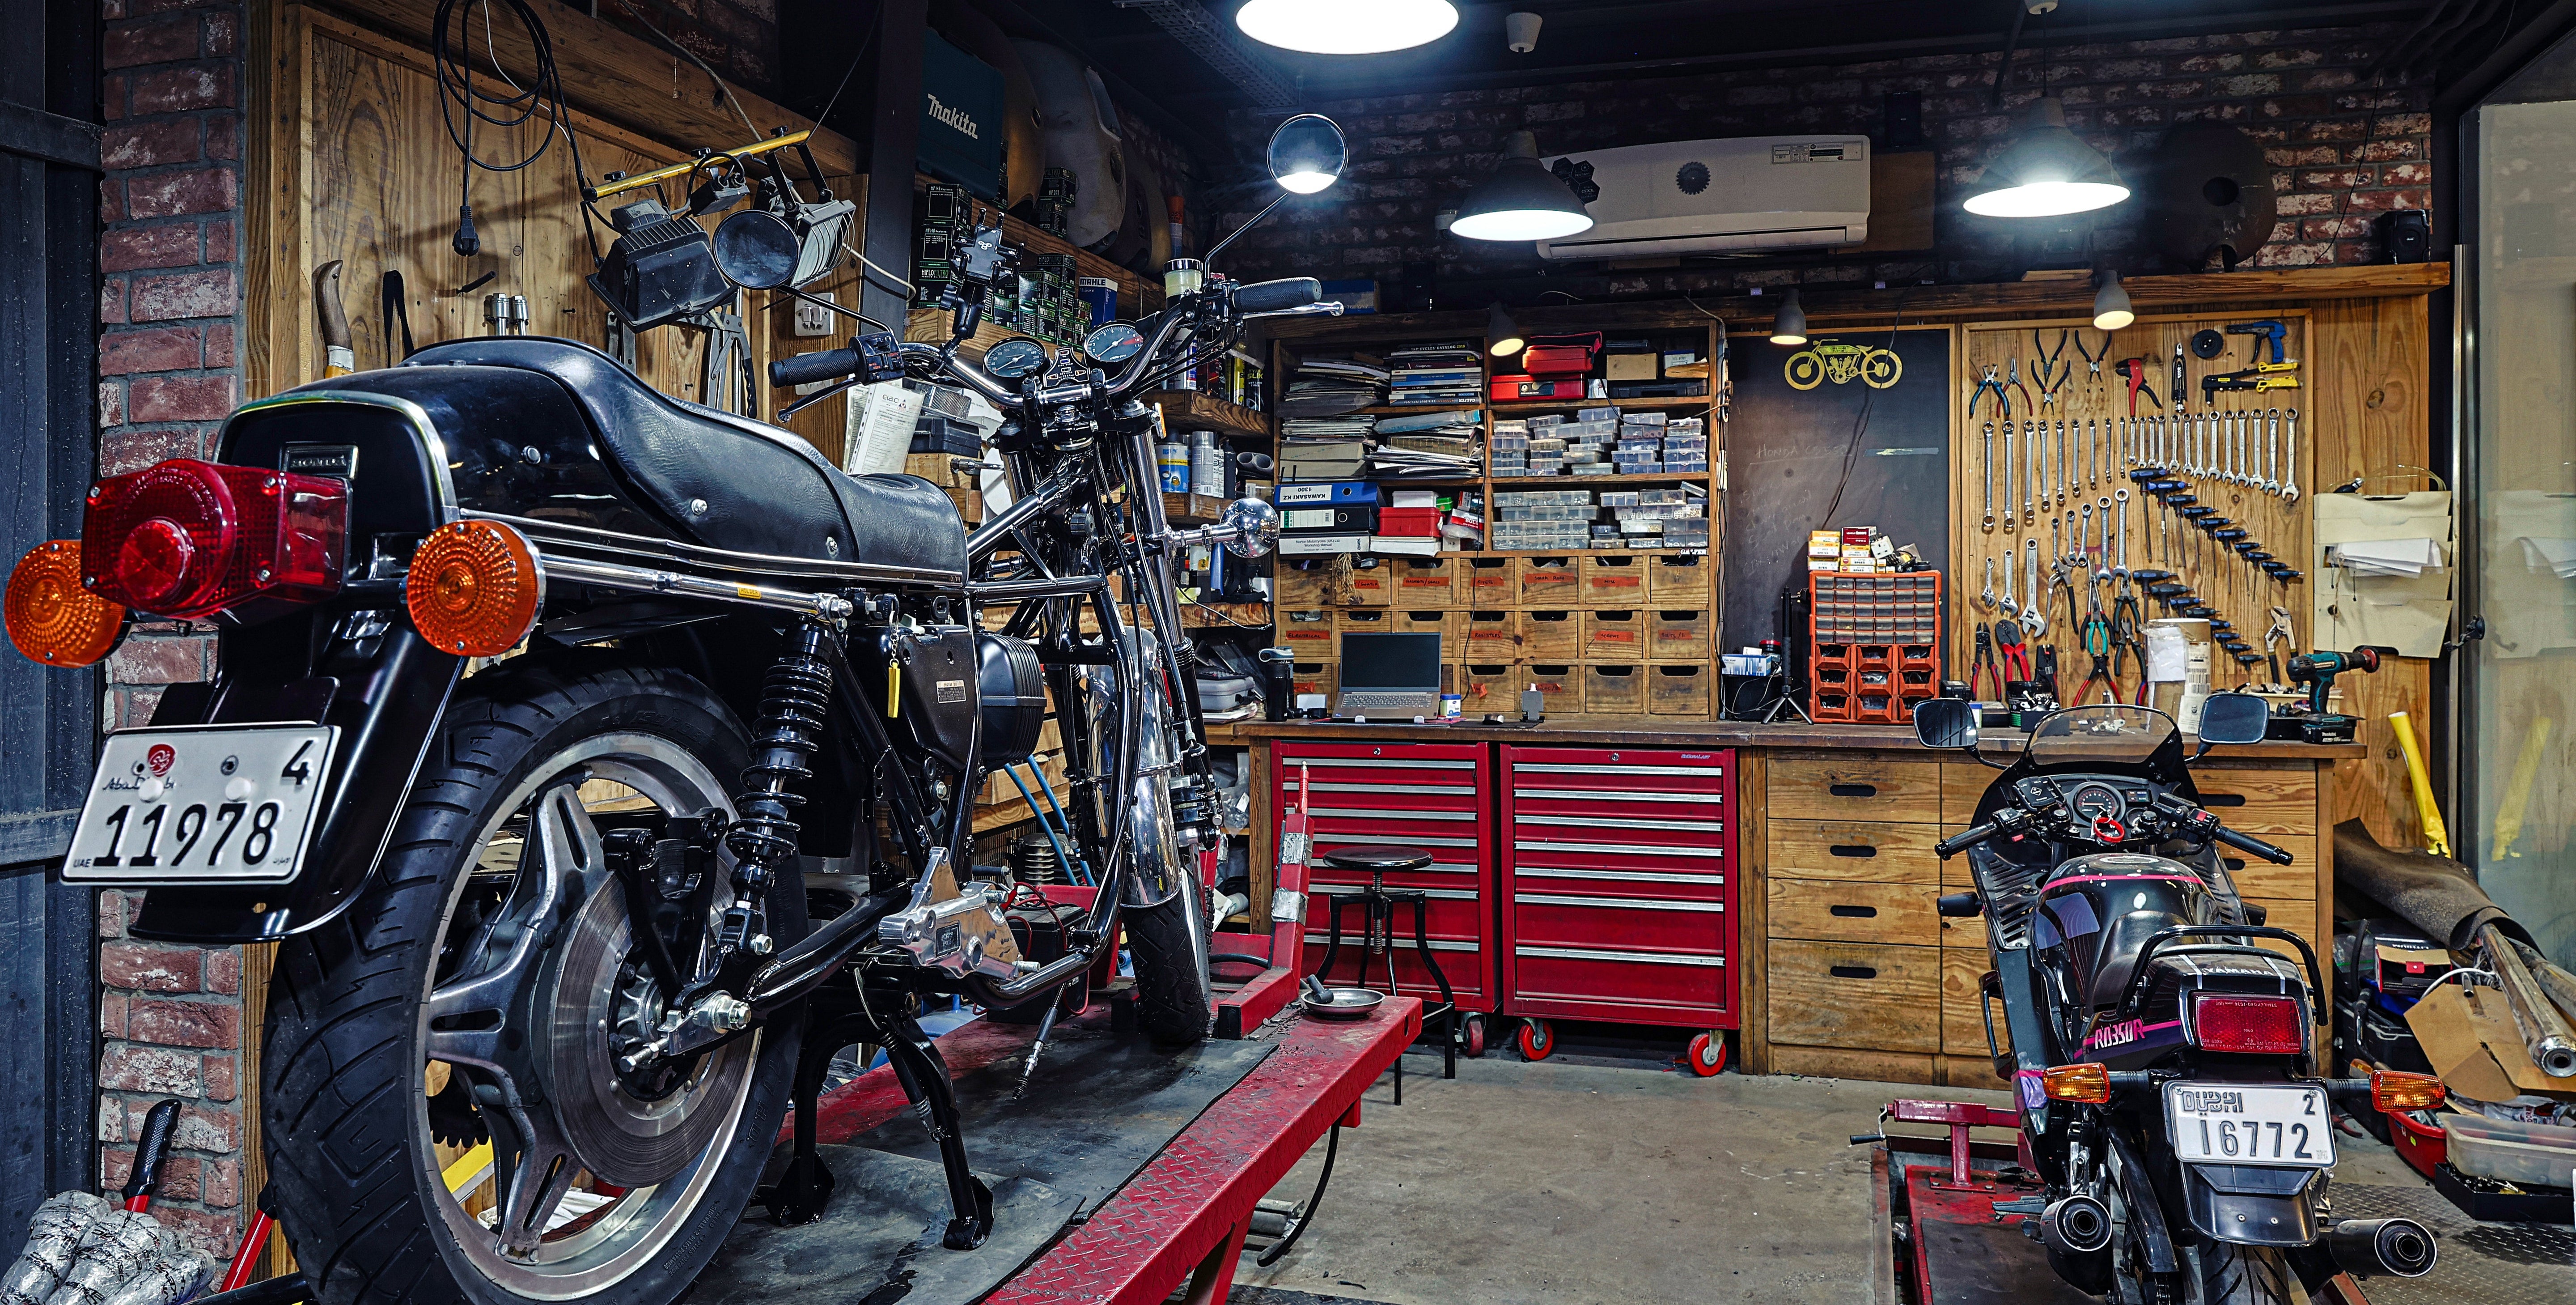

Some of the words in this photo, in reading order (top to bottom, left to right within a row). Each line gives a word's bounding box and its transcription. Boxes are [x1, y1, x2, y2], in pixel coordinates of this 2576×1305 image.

[928, 94, 978, 139] Makita
[1756, 444, 1798, 458] HONDA
[282, 740, 315, 790] 4
[135, 776, 177, 791] Dbi
[93, 802, 280, 868] 11978
[73, 859, 92, 869] UAE
[2303, 1094, 2315, 1115] 2
[2200, 1120, 2312, 1158] 16772
[682, 1236, 695, 1249] PLIES
[664, 1247, 685, 1270] POLYAMIDE
